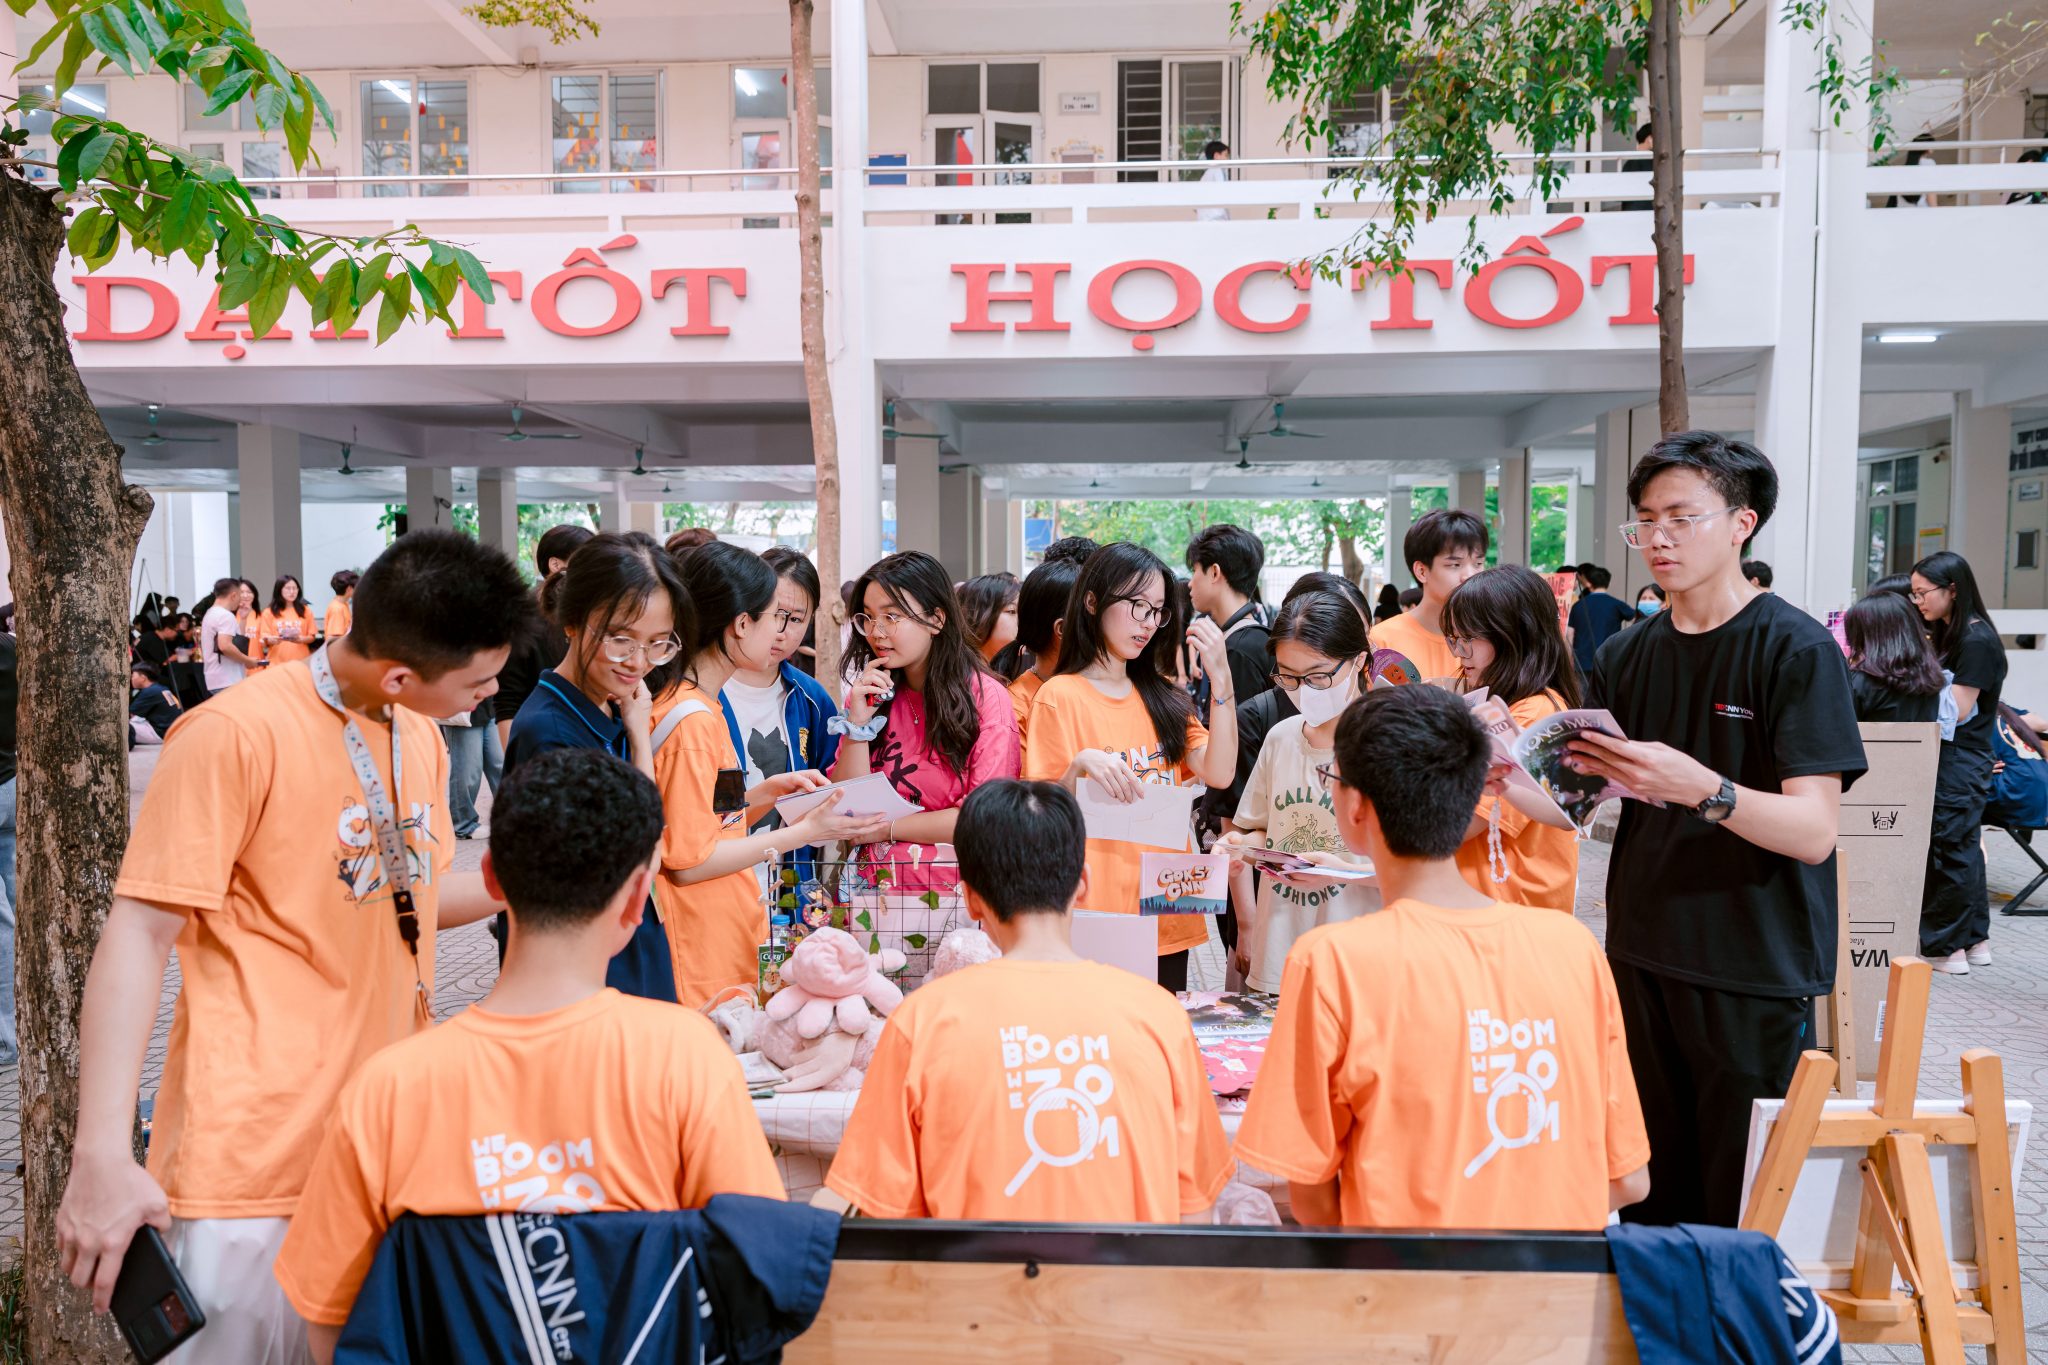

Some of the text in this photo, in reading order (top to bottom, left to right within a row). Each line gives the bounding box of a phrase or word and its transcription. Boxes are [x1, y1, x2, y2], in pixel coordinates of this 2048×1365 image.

[950, 259, 1313, 351] HỌC
[1351, 216, 1695, 331] TỐT
[1274, 786, 1313, 811] CALL
[1165, 879, 1205, 902] CNN
[1270, 879, 1347, 907] ASHIONE
[1467, 1008, 1490, 1026] WE
[1000, 1025, 1028, 1042] WE
[1469, 1018, 1556, 1053] BOOM
[1002, 1033, 1110, 1069] BOOM
[471, 1133, 506, 1157] WE
[475, 1137, 595, 1188] BOOM
